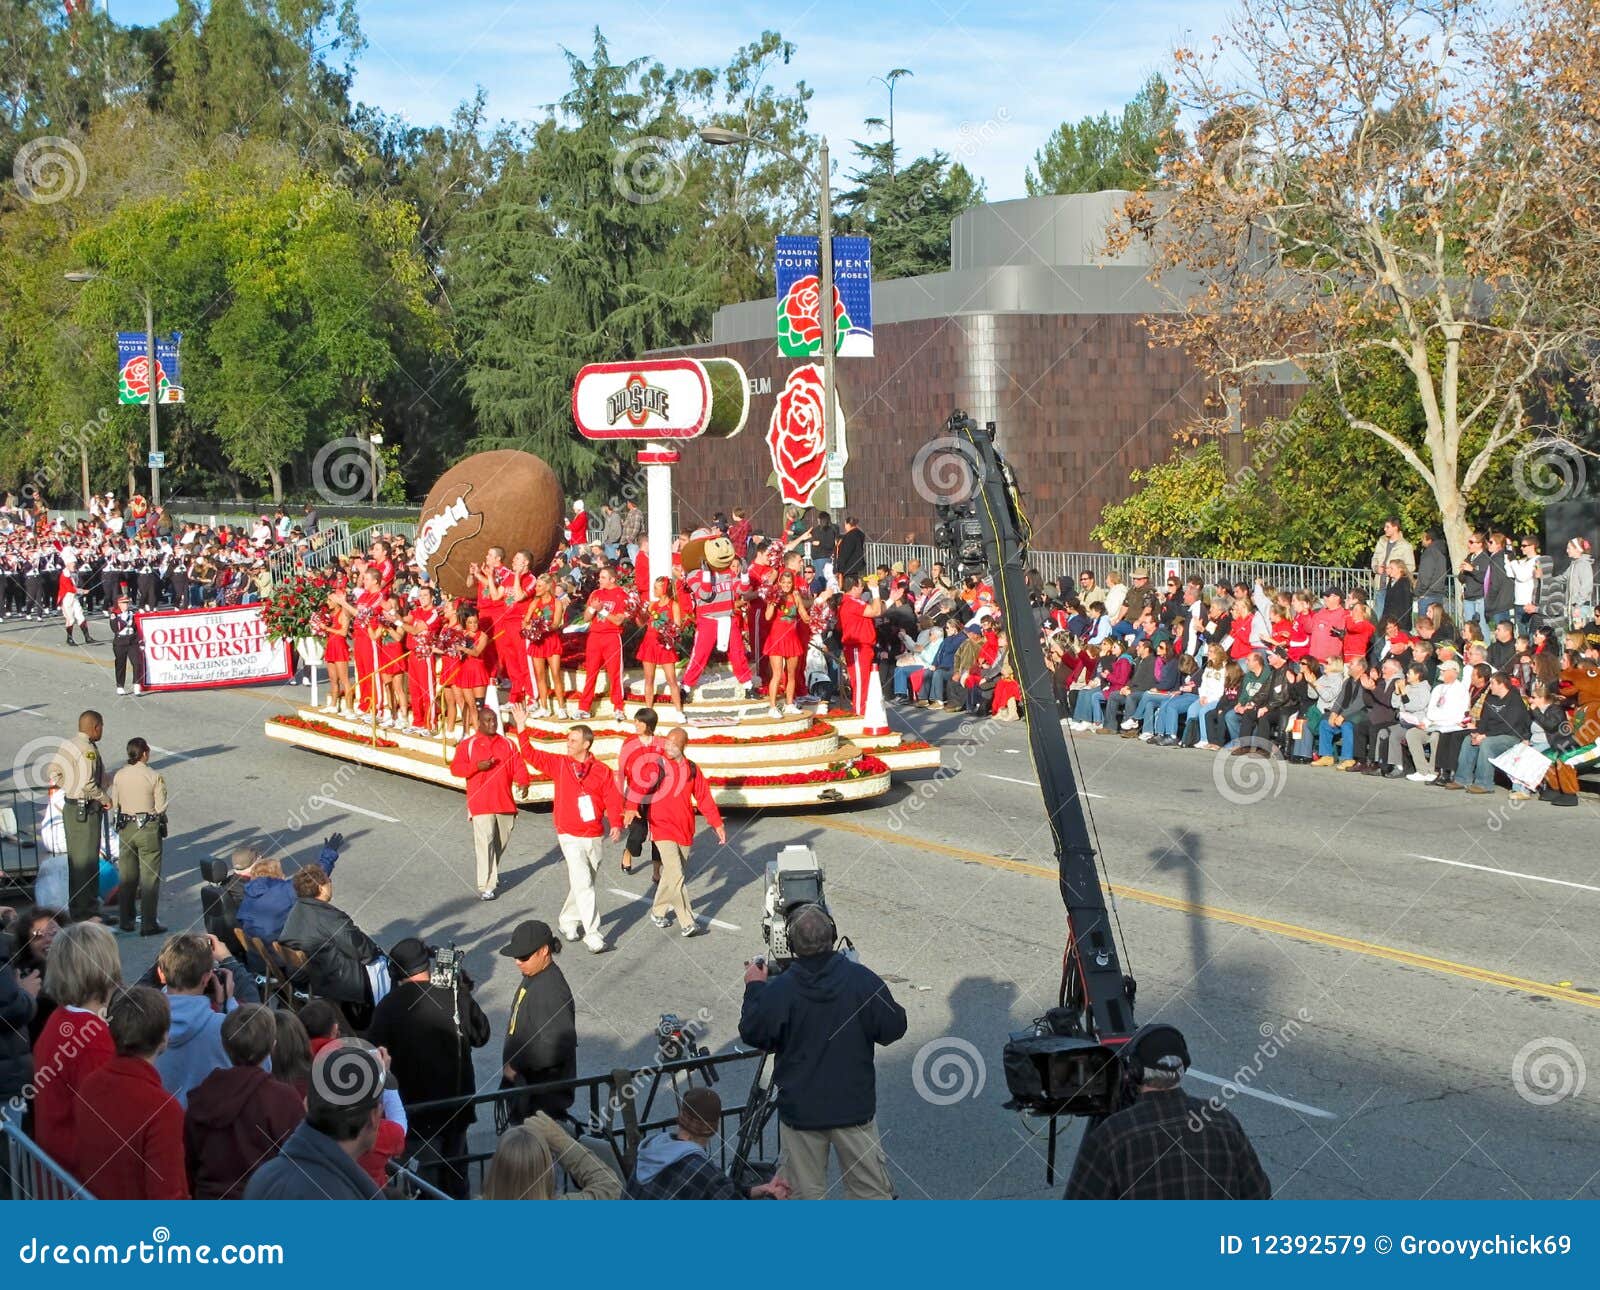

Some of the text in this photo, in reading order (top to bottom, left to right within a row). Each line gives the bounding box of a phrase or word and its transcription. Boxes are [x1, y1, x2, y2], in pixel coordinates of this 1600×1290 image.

[749, 377, 771, 395] EUM
[205, 616, 224, 625] THE
[151, 620, 264, 646] OHIO STAT
[174, 655, 258, 672] MARCHING BAND
